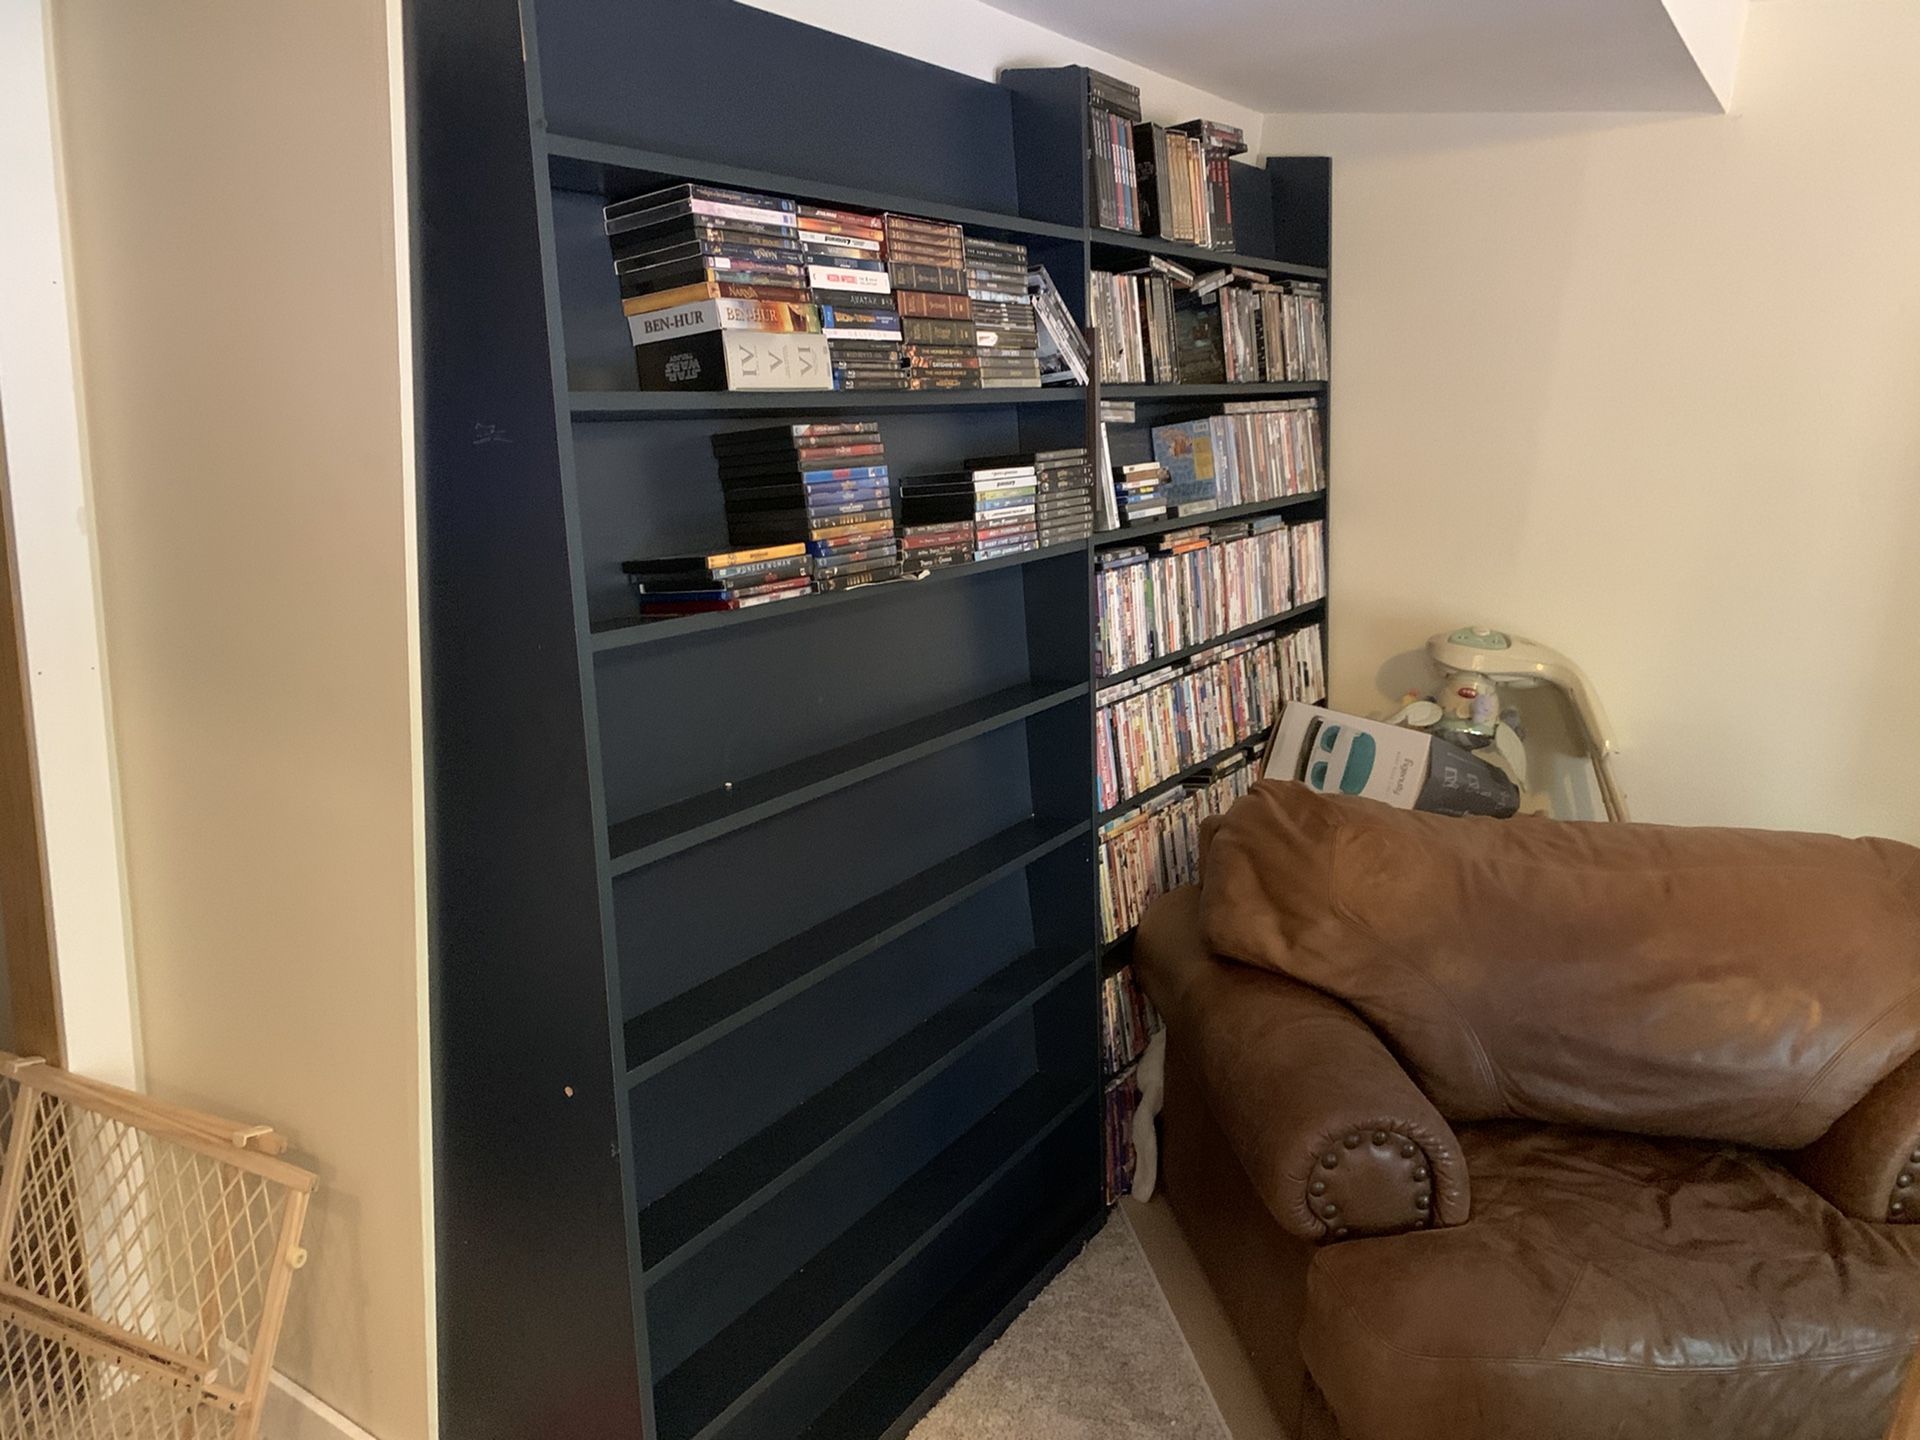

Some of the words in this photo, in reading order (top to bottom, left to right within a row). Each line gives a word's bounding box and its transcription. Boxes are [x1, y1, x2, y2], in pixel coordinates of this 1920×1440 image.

[727, 307, 778, 322] BEN-HUR
[644, 310, 704, 334] BEN-HUR
[665, 358, 701, 372] WARS
[665, 368, 702, 382] STAR
